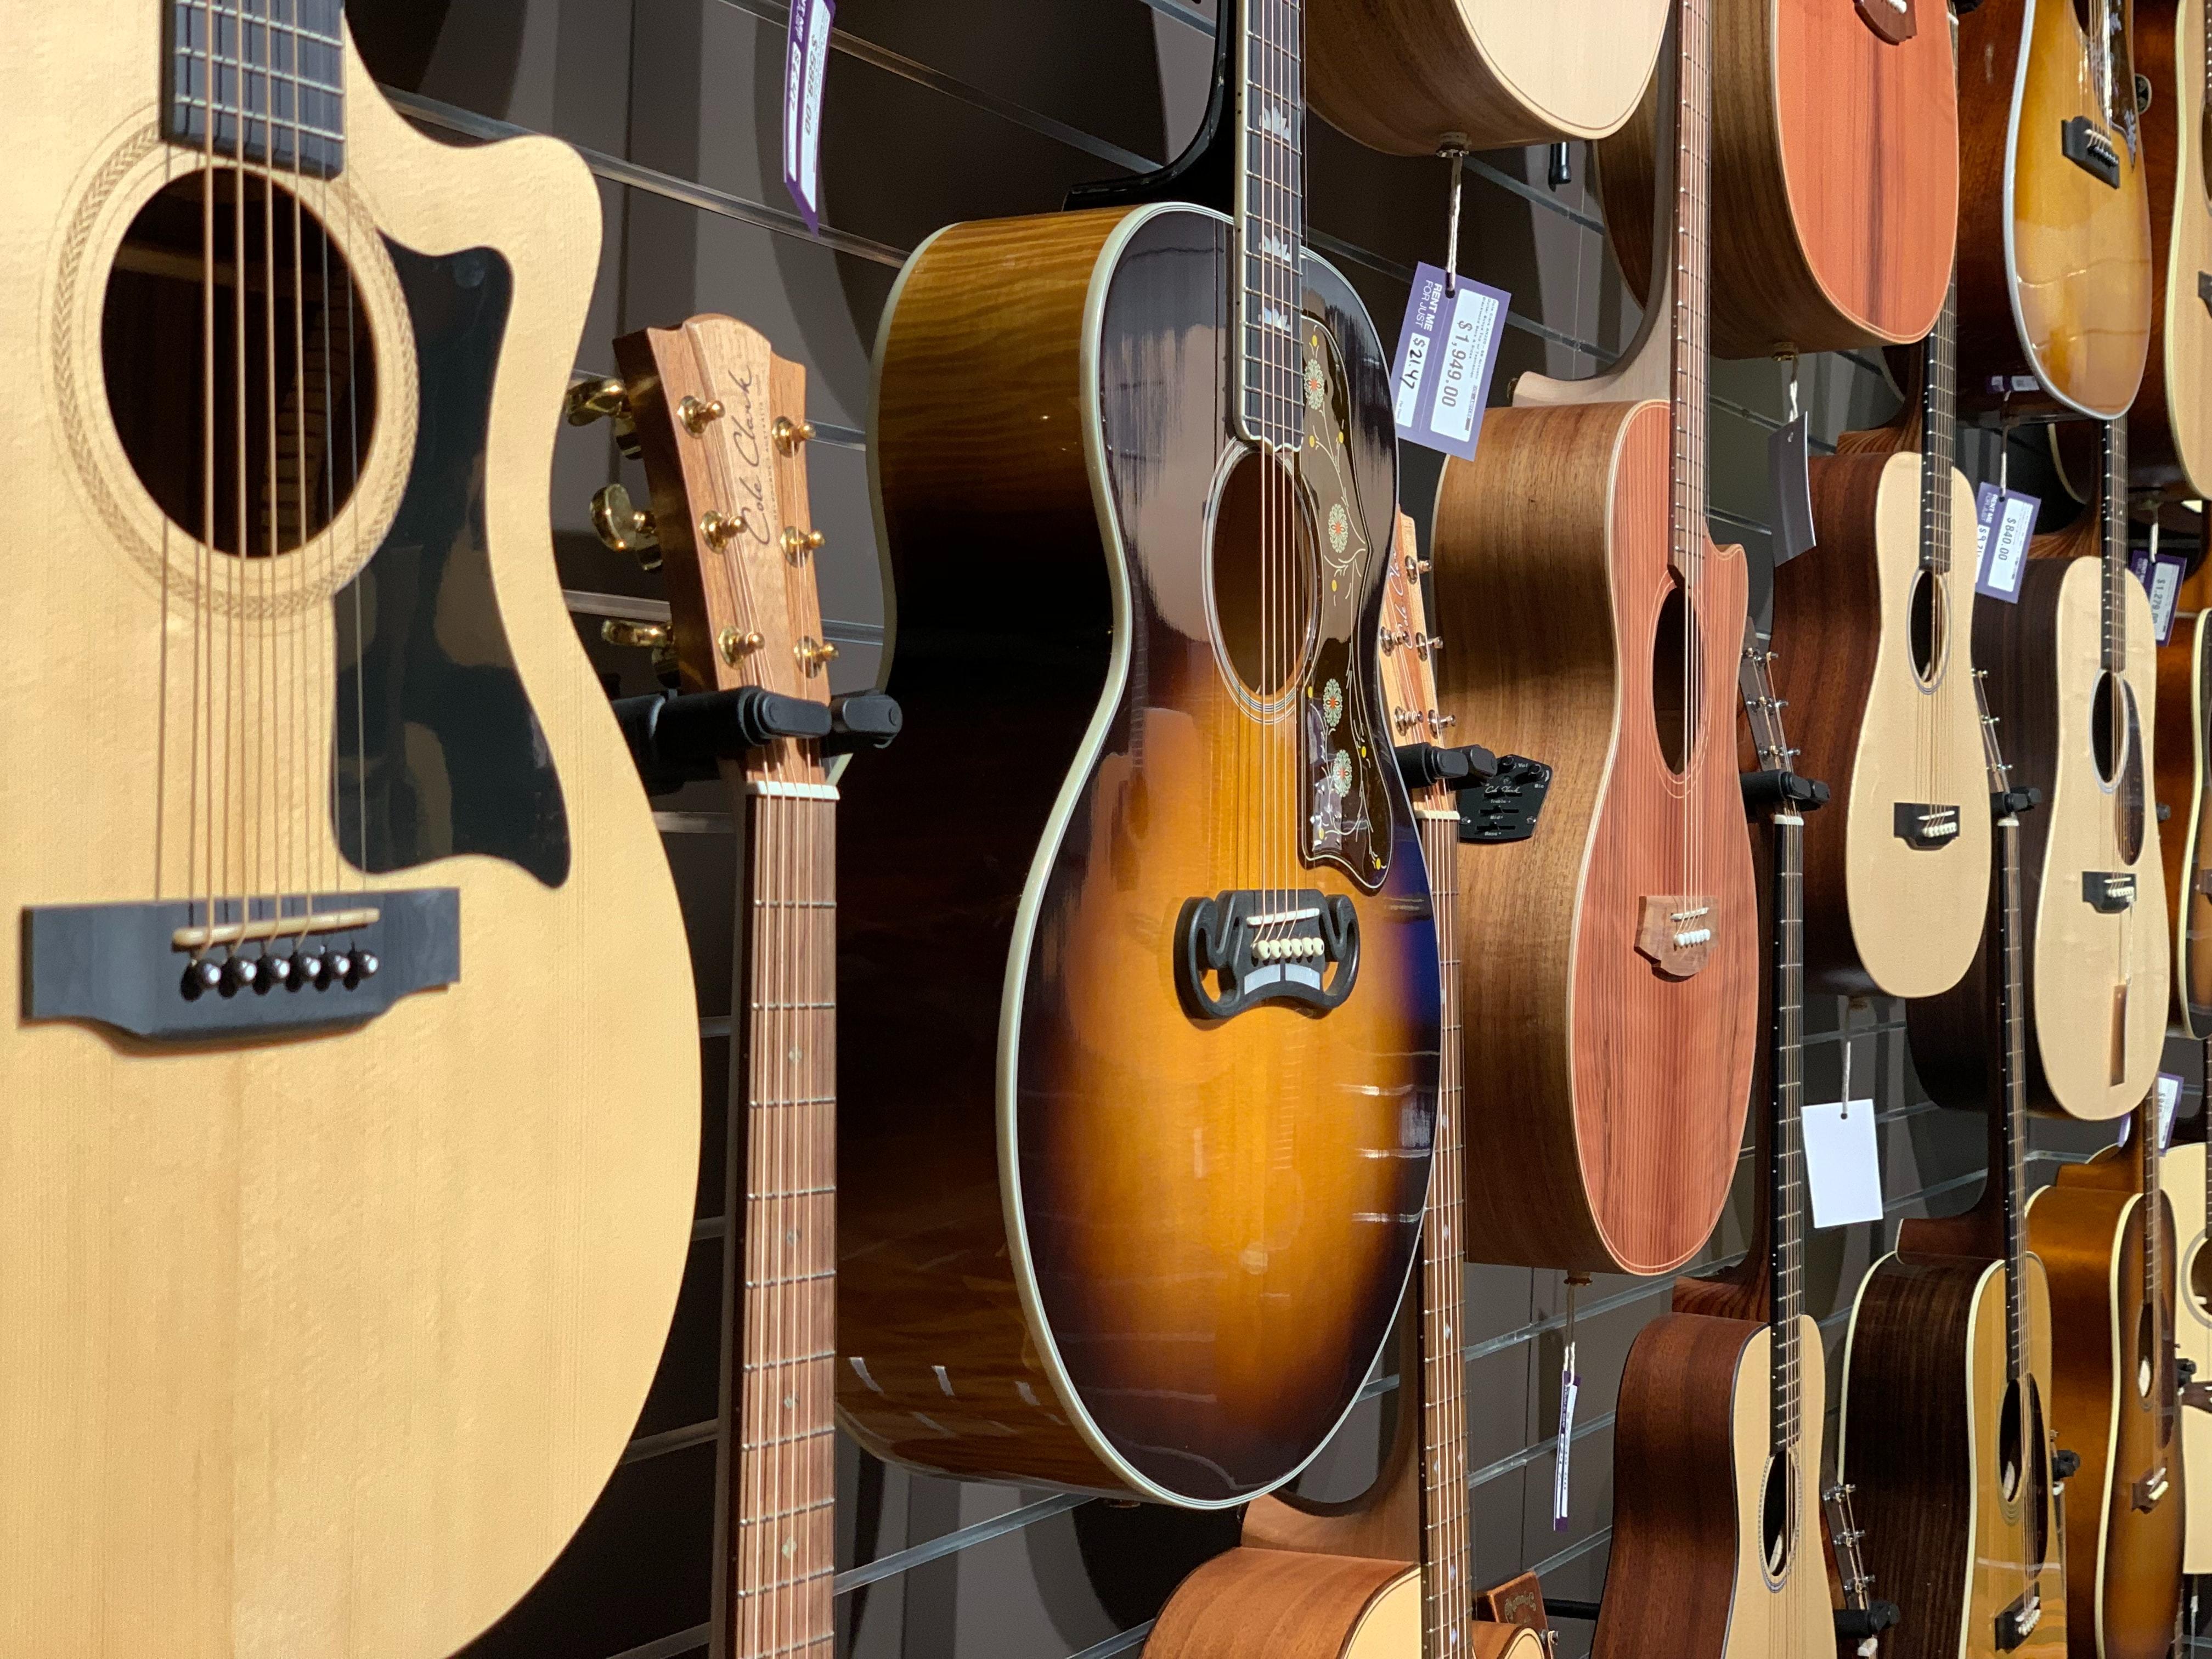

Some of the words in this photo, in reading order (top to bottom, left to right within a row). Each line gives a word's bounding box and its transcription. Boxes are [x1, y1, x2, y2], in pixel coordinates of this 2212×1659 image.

[1421, 280, 1433, 301] FOR
[1428, 283, 1442, 312] RENT
[1415, 302, 1427, 328] JUST
[1423, 313, 1435, 331] ME
[728, 366, 760, 467] Clark
[738, 476, 770, 544] Cole
[1989, 494, 1997, 511] RENT
[1985, 513, 1993, 523] ME
[1395, 603, 1412, 648] Cole
